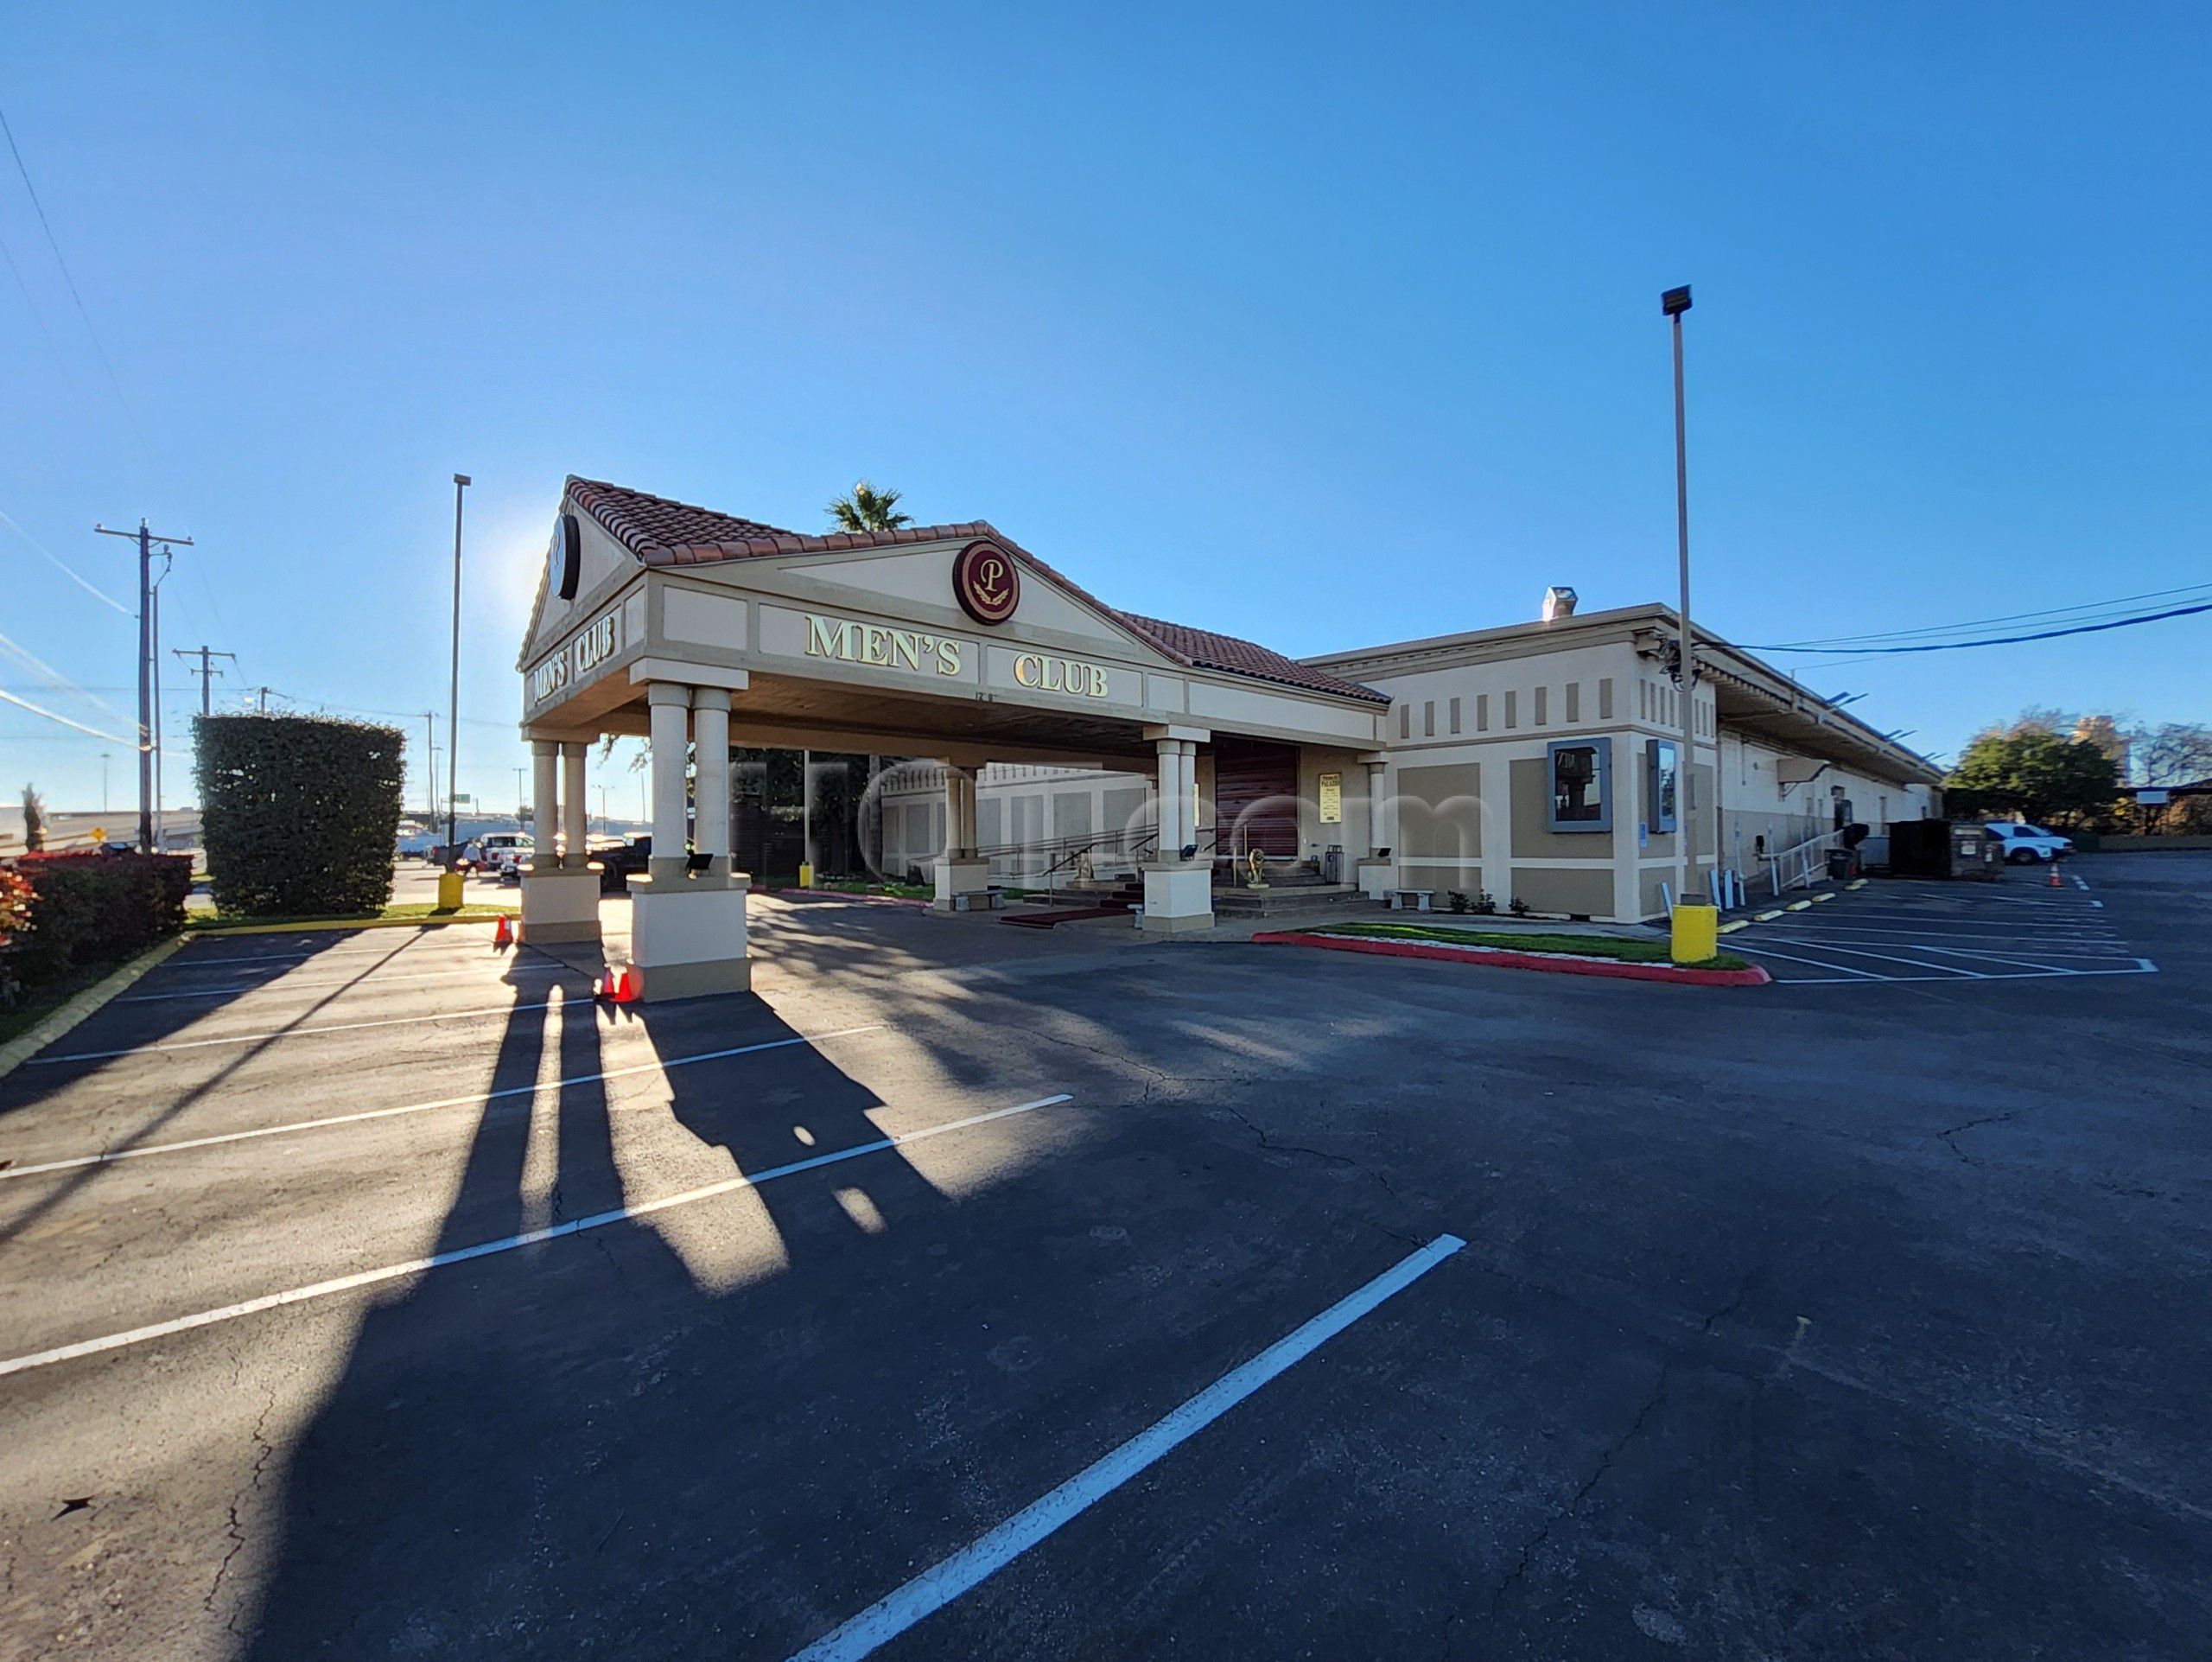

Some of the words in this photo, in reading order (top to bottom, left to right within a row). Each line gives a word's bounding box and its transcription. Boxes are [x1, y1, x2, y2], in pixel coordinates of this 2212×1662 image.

[980, 558, 1004, 592] P
[534, 650, 568, 706] MEN'S
[575, 614, 615, 672] CLUB
[804, 614, 962, 677] MEN'S
[1013, 653, 1109, 698] CLUB
